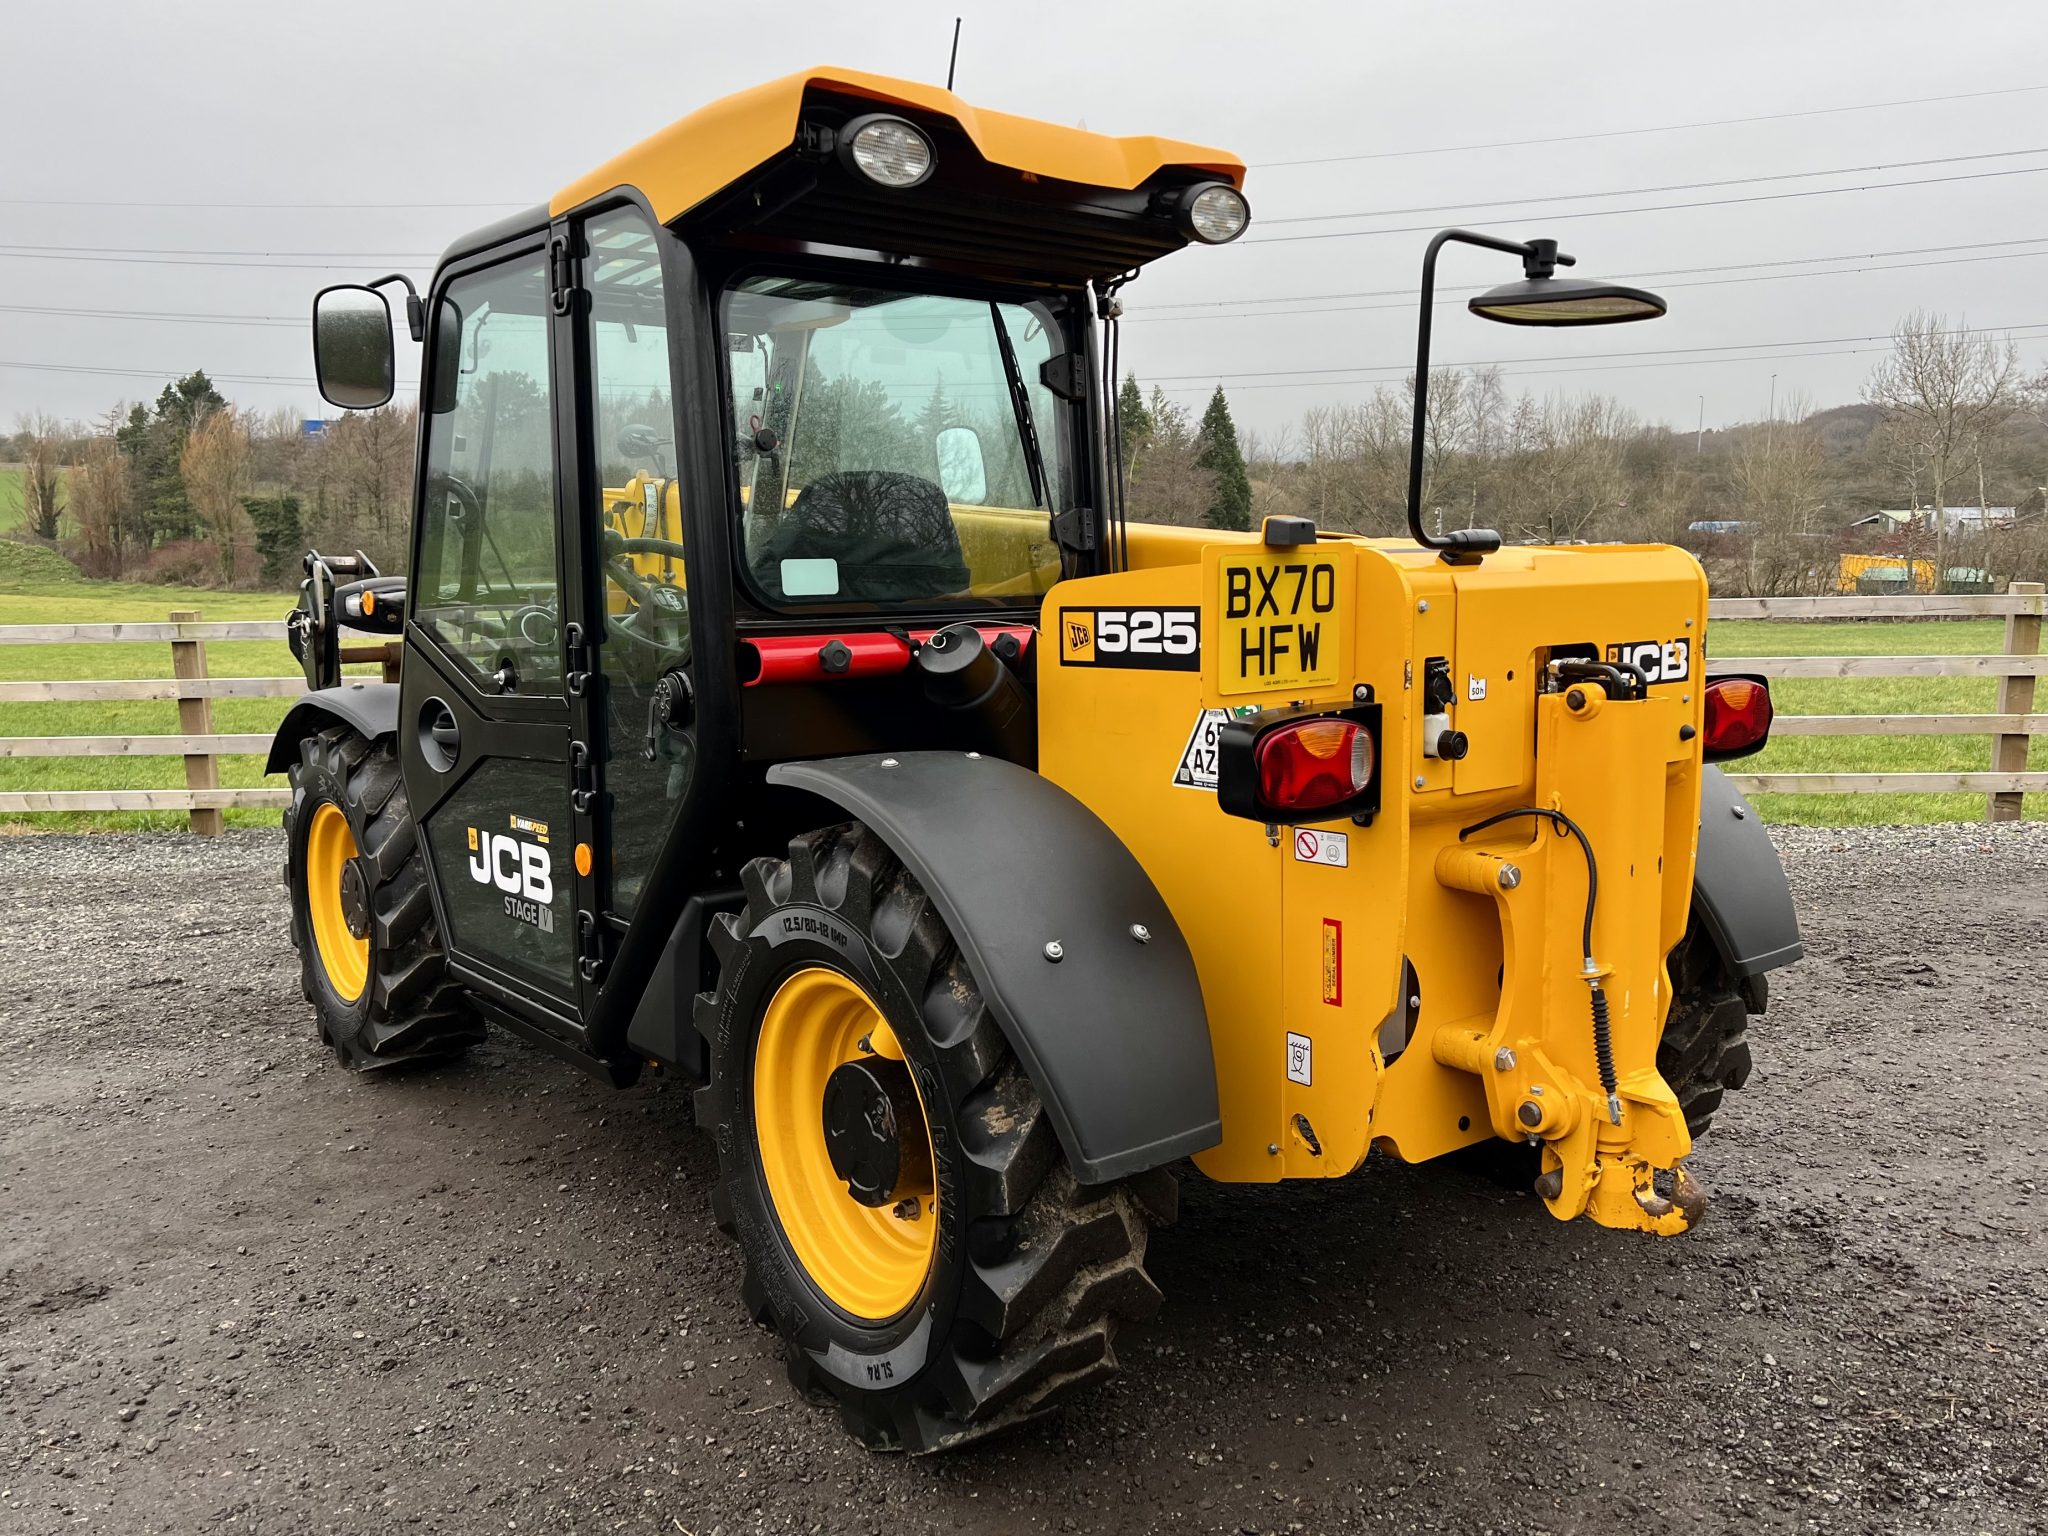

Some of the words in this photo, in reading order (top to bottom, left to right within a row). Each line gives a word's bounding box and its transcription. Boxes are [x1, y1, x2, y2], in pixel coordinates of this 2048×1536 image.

[1226, 563, 1335, 619] BX70
[1070, 625, 1089, 649] JCB
[1097, 611, 1197, 655] 525
[1240, 622, 1320, 678] HFW
[469, 830, 553, 905] JCB
[504, 896, 538, 925] STAGE
